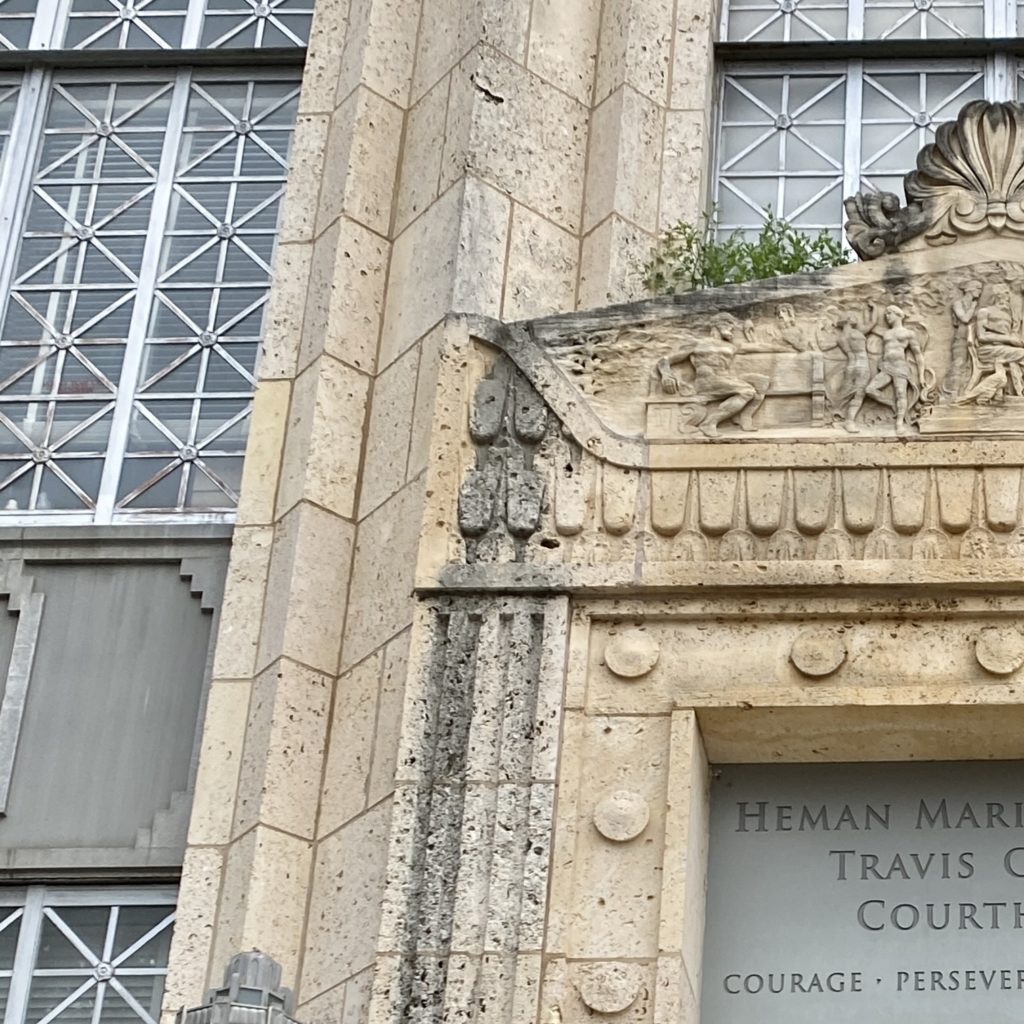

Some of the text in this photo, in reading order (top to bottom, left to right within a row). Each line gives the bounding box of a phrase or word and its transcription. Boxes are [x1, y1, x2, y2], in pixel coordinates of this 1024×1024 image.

[735, 801, 892, 833] HEMAN
[829, 850, 975, 881] TRAVIS
[723, 972, 863, 994] COURAGE
